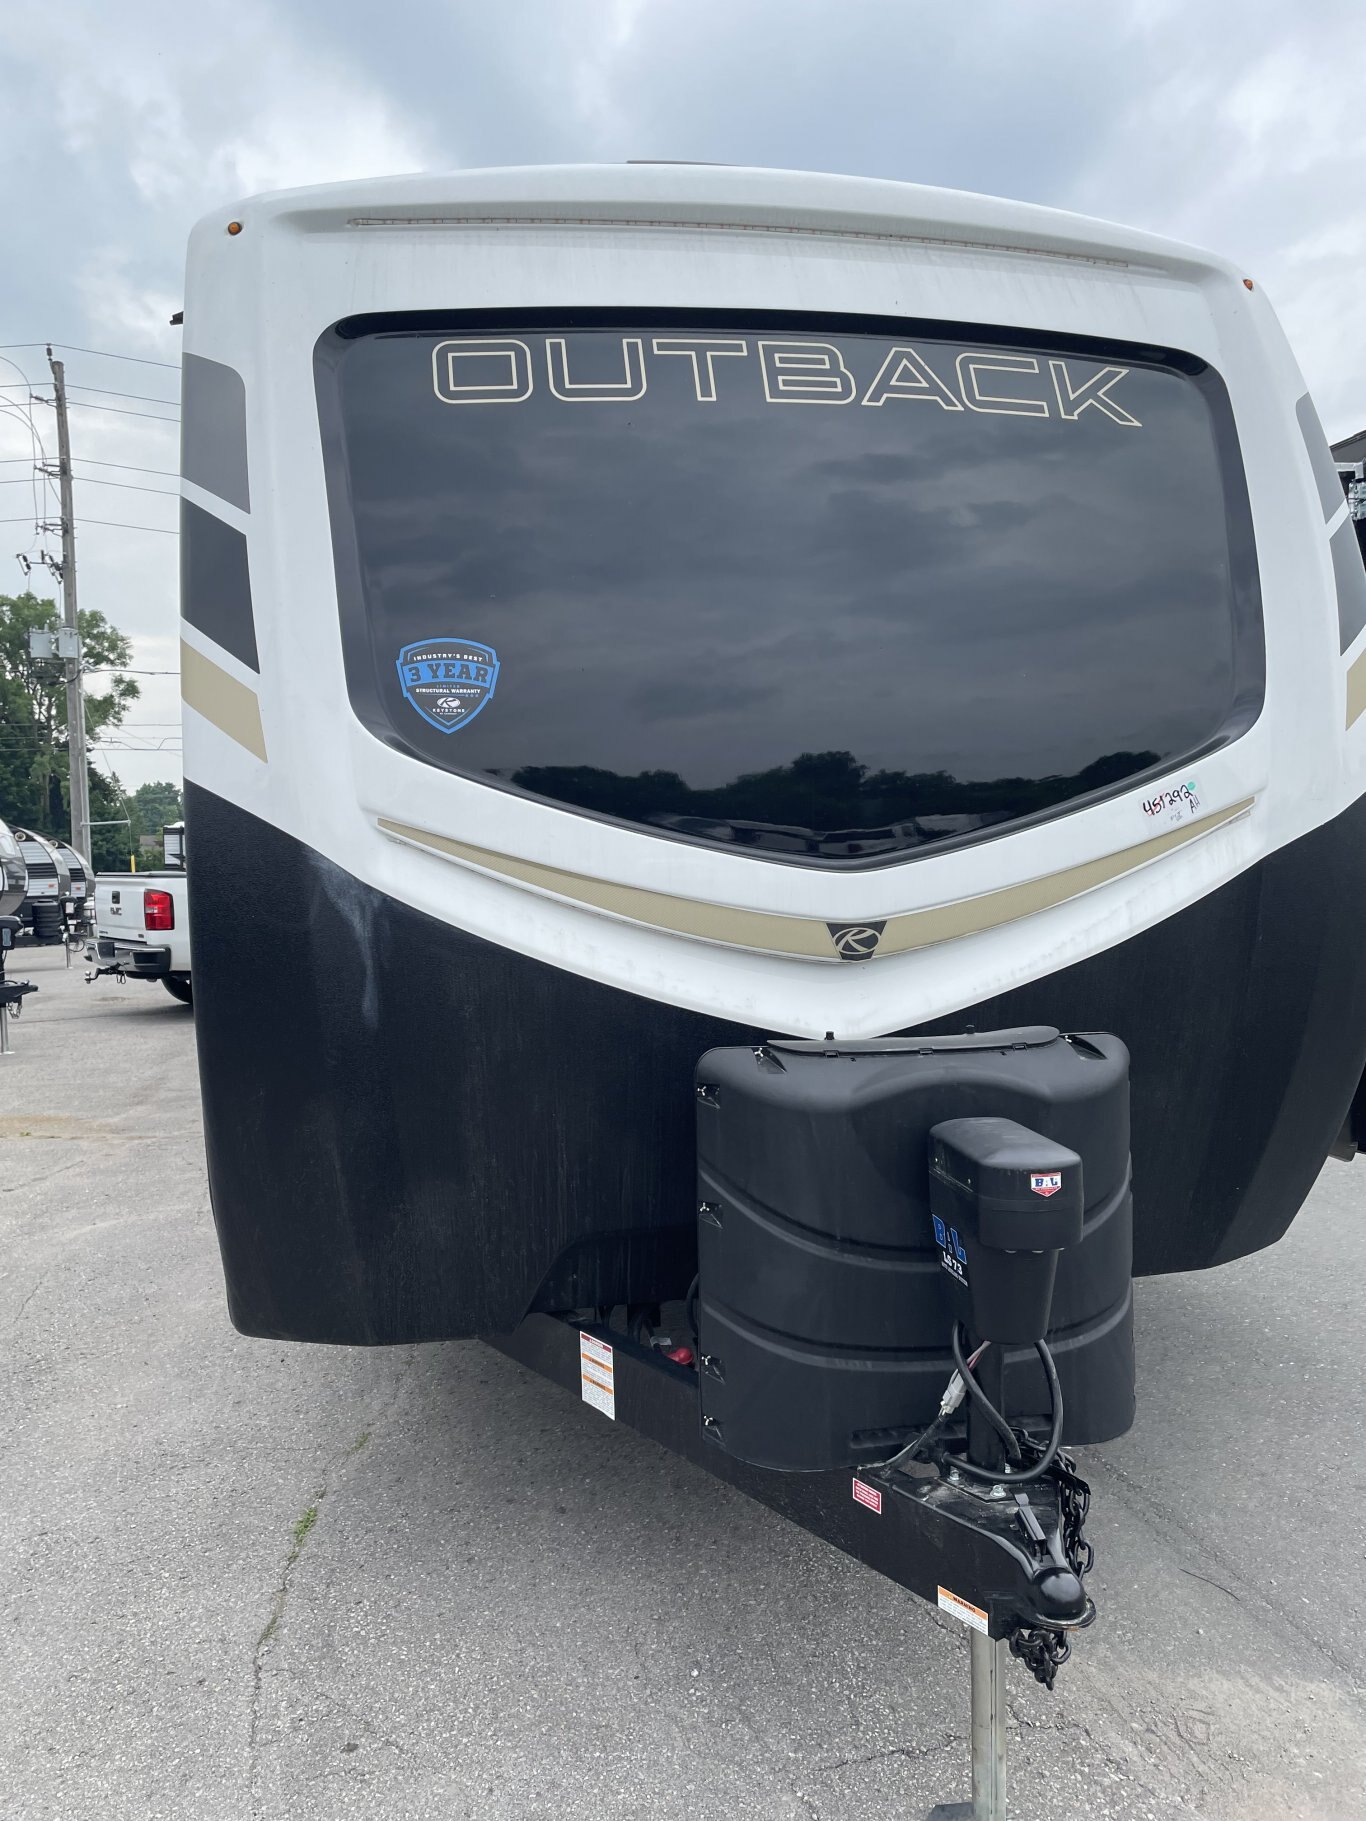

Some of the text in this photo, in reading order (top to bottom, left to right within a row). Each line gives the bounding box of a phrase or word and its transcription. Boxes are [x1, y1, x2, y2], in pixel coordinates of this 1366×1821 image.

[432, 338, 1142, 427] OUTBACK
[413, 653, 460, 661] INDUSTRY'S
[408, 662, 489, 683] 3 YEAR
